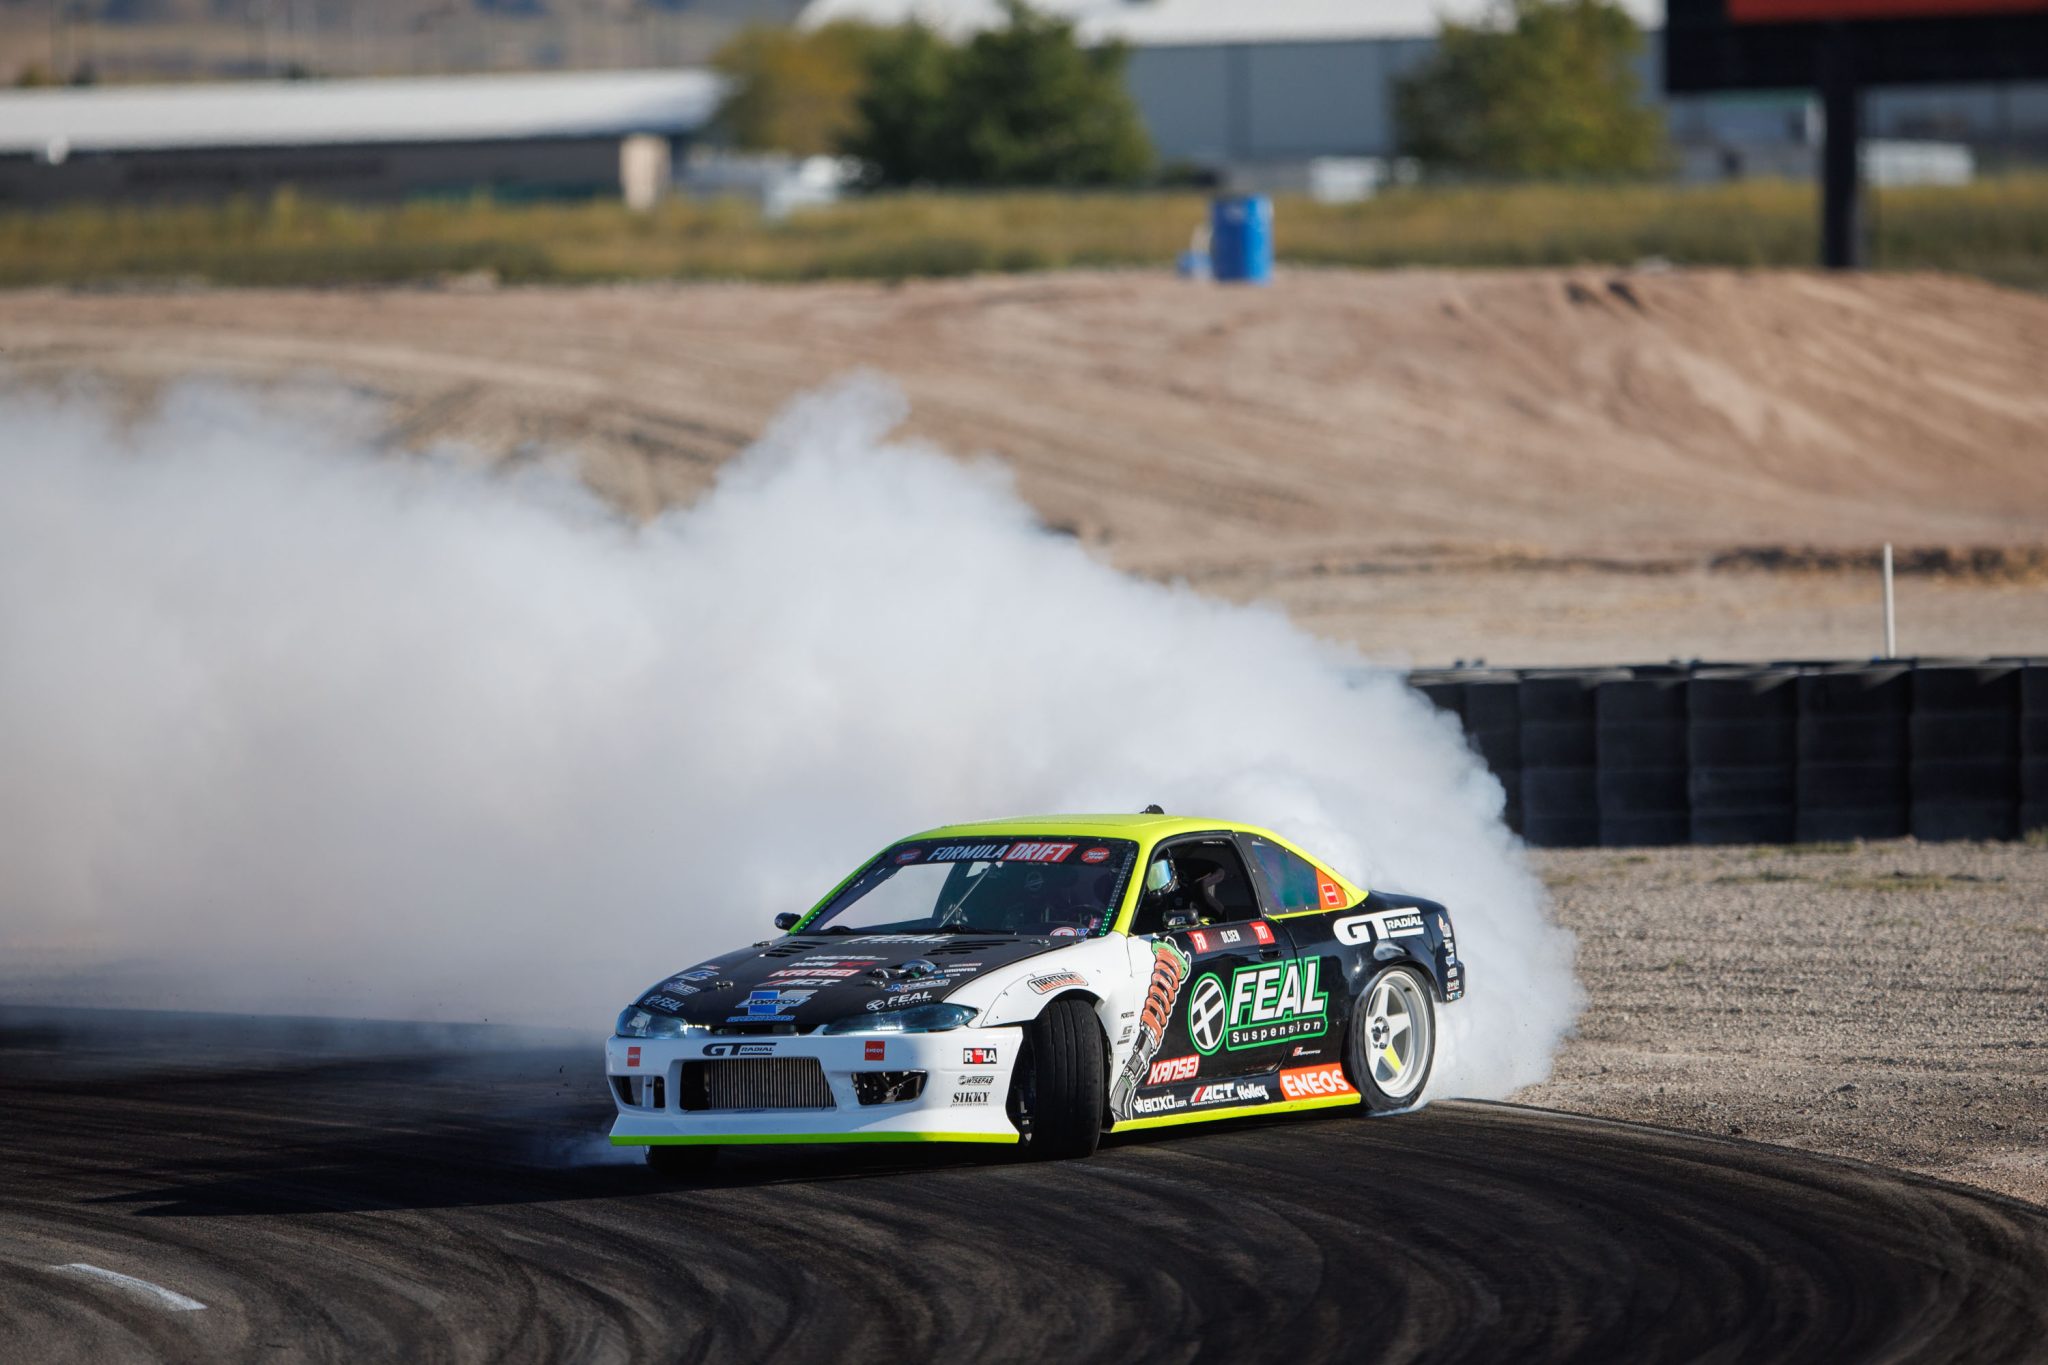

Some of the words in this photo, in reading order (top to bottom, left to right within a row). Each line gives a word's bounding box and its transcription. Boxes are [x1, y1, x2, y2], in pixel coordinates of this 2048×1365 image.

[927, 843, 1011, 861] FORMULA
[1007, 842, 1074, 860] DRIFT
[1333, 907, 1421, 946] GT
[1385, 914, 1424, 930] RADIAL
[1220, 929, 1241, 944] OLSEN
[768, 969, 861, 978] KANSEI
[888, 991, 932, 1005] FEAL
[1229, 962, 1325, 1026] FEAL
[1232, 1020, 1321, 1043] Suspension
[702, 1043, 777, 1057] GT
[1147, 1055, 1200, 1085] KANSEI
[966, 1076, 994, 1084] WISEFAB
[1281, 1070, 1350, 1097] ENEOS
[953, 1091, 990, 1103] SIKKY
[1200, 1082, 1235, 1101] ACT
[1237, 1083, 1270, 1101] Holley
[1143, 1095, 1175, 1113] BOXO
[1174, 1100, 1188, 1108] USA
